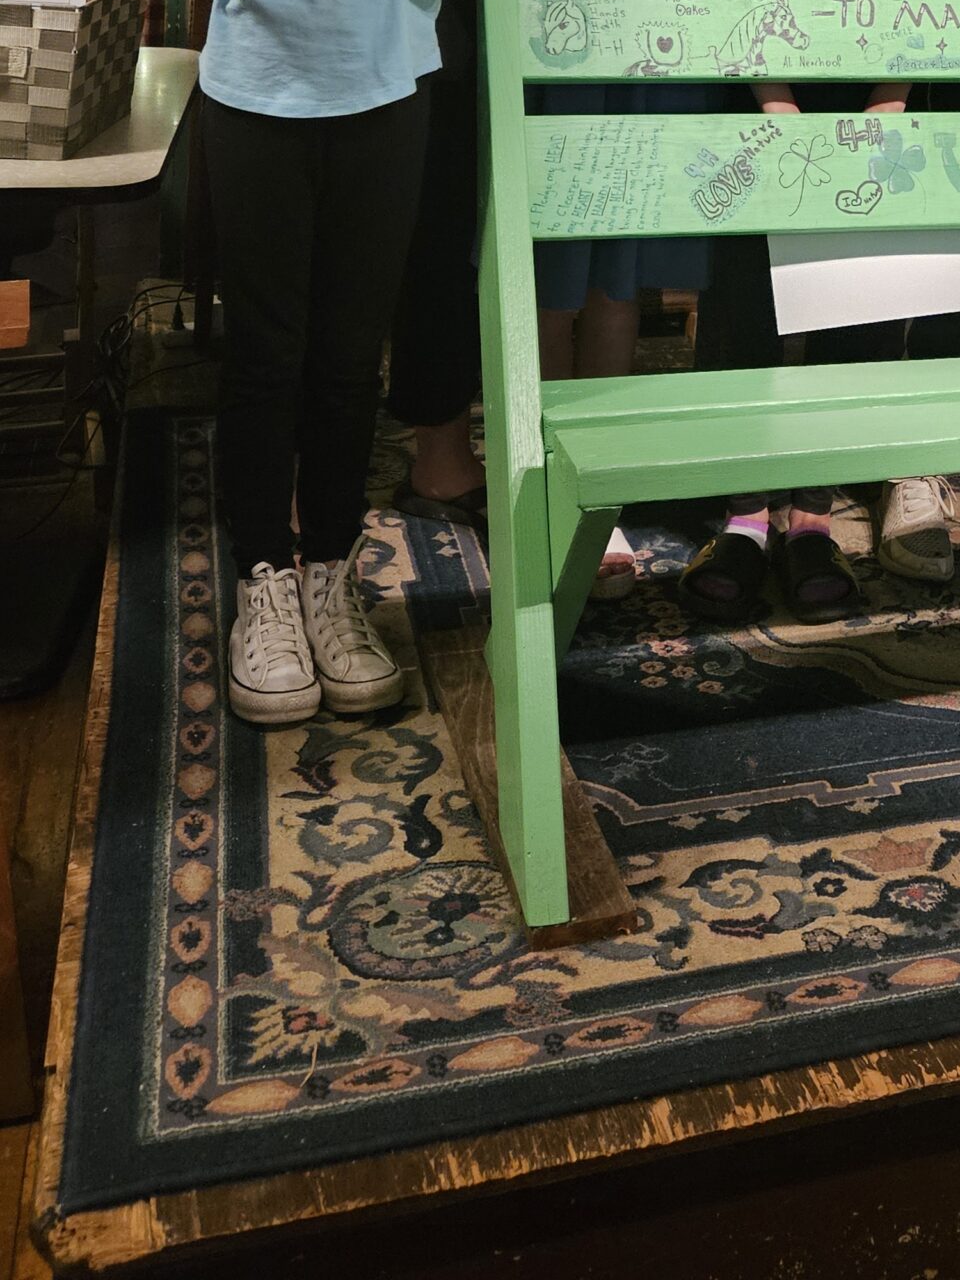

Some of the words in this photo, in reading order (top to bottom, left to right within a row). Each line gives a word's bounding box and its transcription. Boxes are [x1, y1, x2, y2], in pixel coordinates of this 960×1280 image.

[675, 4, 711, 17] Oakes
[739, 119, 775, 143] Love
[743, 127, 783, 160] Nature
[544, 133, 563, 163] HEAD
[695, 155, 755, 219] LOVE
[571, 188, 593, 217] HEART
